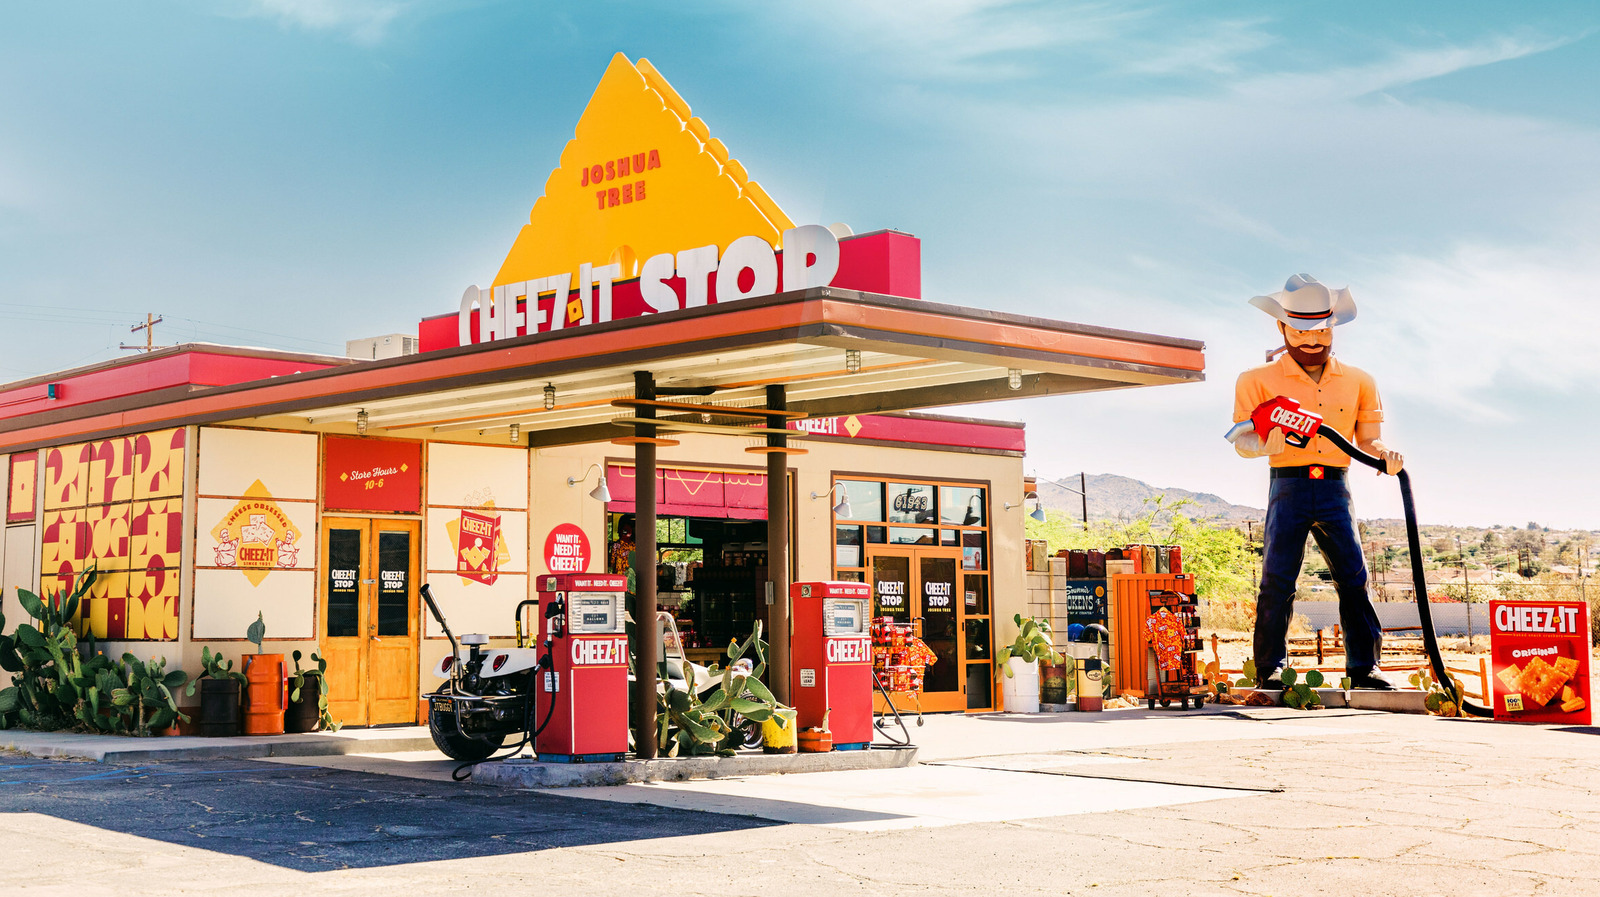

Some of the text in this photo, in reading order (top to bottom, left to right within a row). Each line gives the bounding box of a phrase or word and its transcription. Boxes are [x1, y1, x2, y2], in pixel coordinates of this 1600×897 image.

[581, 149, 661, 187] JOSHUA
[596, 180, 646, 210] TREE
[640, 224, 840, 316] STOP
[350, 467, 398, 481] Store Hours
[365, 478, 384, 490] 10-6
[894, 495, 927, 510] 61943
[228, 503, 287, 528] CHEESE OBSESSED
[556, 534, 573, 544] WANT
[554, 544, 573, 556] NEED
[334, 580, 354, 588] STOP
[881, 595, 902, 606] STOP
[929, 596, 949, 606] STOP
[1067, 595, 1094, 610] OKENS
